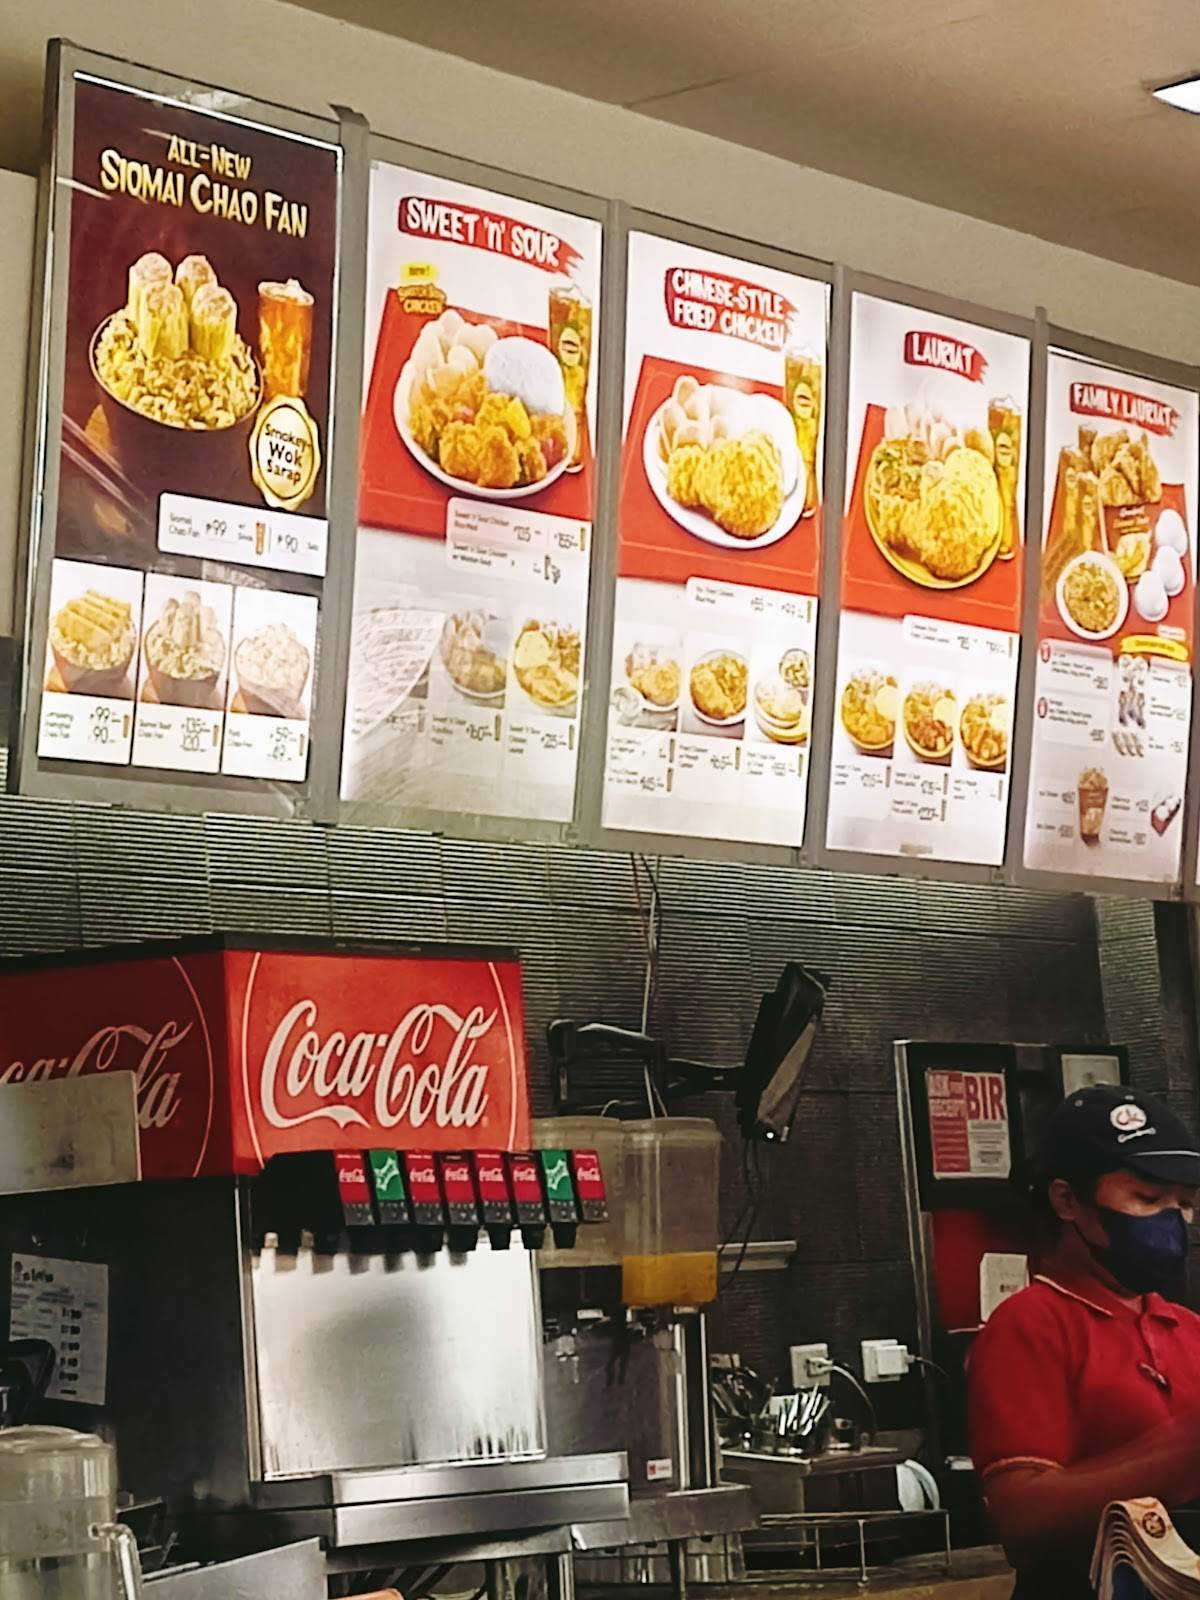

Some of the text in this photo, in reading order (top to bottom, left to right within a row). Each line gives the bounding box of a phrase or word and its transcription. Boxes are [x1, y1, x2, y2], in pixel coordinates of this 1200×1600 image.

[168, 135, 251, 180] ALL-NEW
[190, 173, 258, 226] CHAO
[264, 191, 308, 239] FAN
[407, 198, 480, 243] SWEET
[511, 225, 560, 267] SOUR
[672, 268, 785, 320] CHINESE-STYLE
[673, 297, 785, 347] FRIED CHICKEN
[912, 332, 975, 374] LAURIAT
[1074, 383, 1172, 429] FAMILY LAURIAT
[266, 459, 301, 486] Sarap
[269, 441, 303, 468] Wok
[261, 999, 498, 1128] Coca-Cola
[964, 1075, 1007, 1121] BIR
